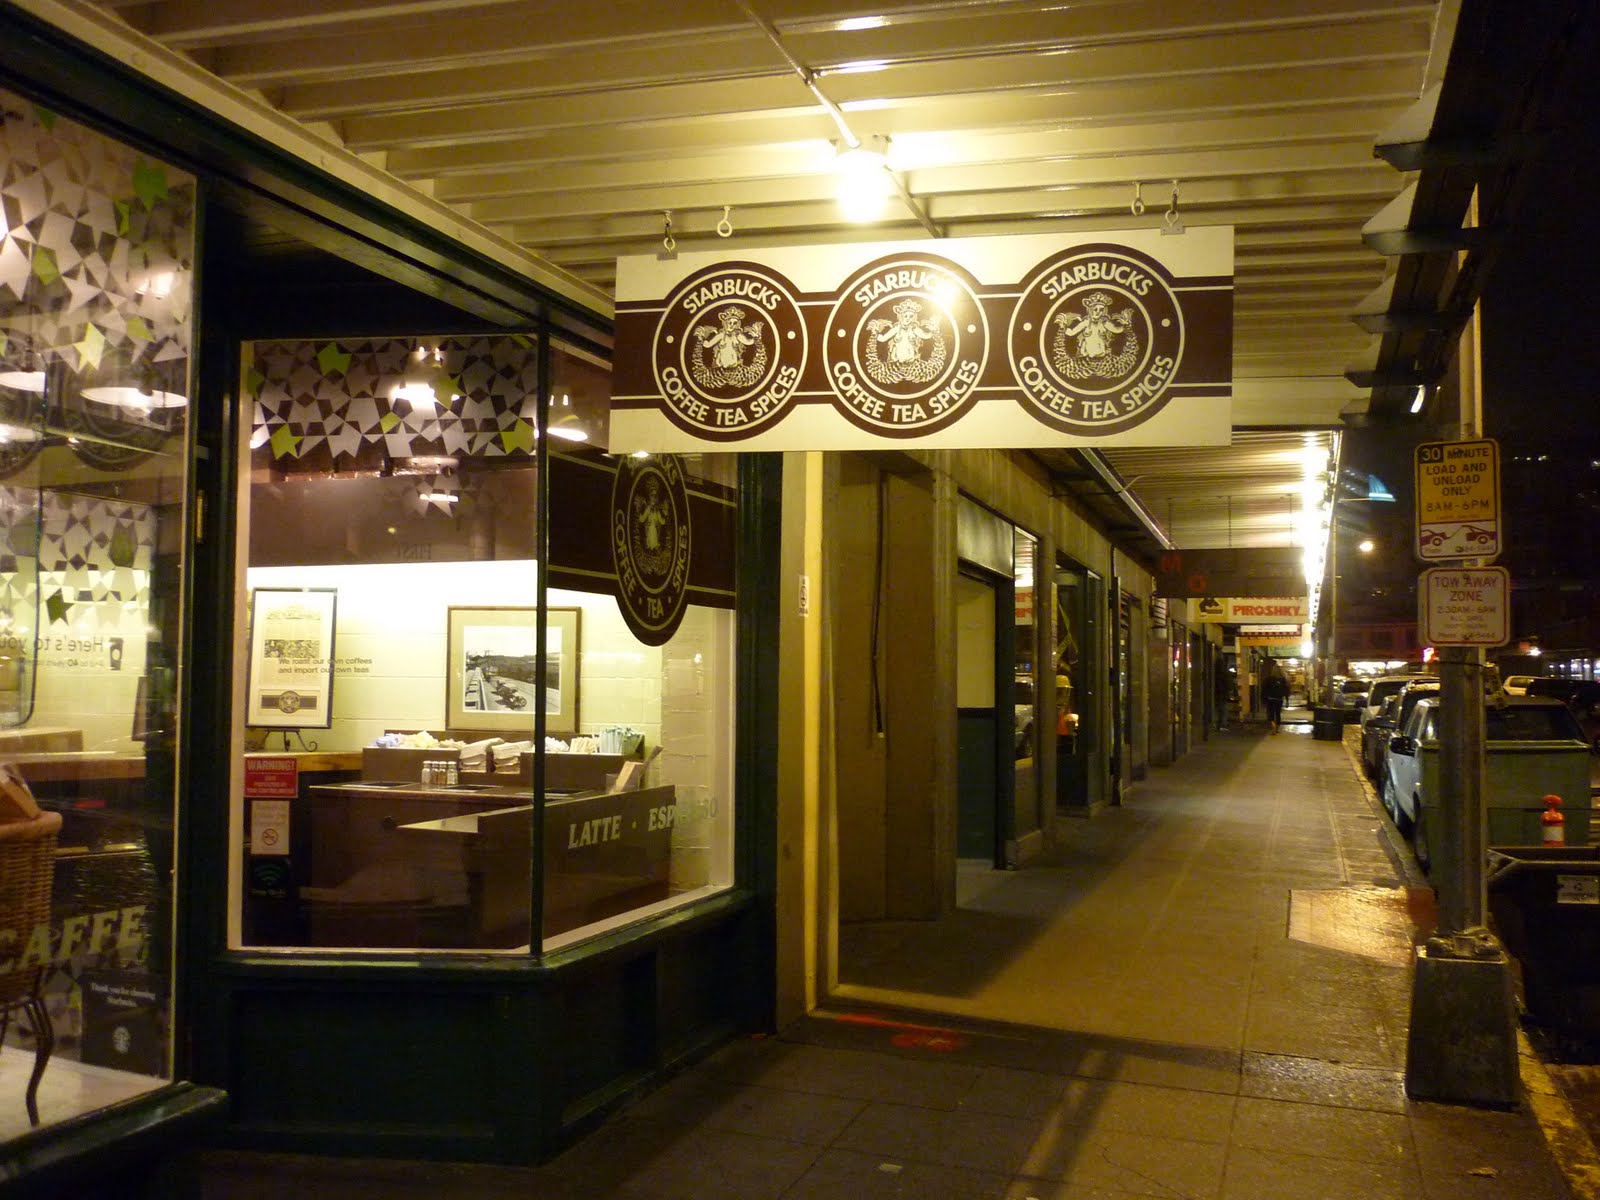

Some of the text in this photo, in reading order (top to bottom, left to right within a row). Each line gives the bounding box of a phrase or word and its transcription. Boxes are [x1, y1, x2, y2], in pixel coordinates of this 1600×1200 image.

[855, 270, 952, 307] STARBUC
[1041, 262, 1153, 300] STARBUCKS
[683, 279, 781, 314] STARBUCKS
[662, 365, 797, 425] COFFEE TEA SPICES
[834, 360, 978, 422] COFFEE TEA SPICES
[1019, 355, 1173, 419] COFFEE TEA SPICES
[1422, 447, 1489, 461] 30 MINUTE
[1426, 462, 1487, 475] LOAD AND
[1433, 474, 1480, 485] UNLOAD
[1442, 485, 1472, 496] ONLY
[615, 509, 689, 619] COFFEE TEA SPICES
[1435, 576, 1498, 588] TOW AWAY
[1450, 590, 1483, 601] ZONE
[1232, 605, 1301, 617] PIROSHKY
[294, 666, 318, 675] import
[568, 815, 622, 849] LATTE
